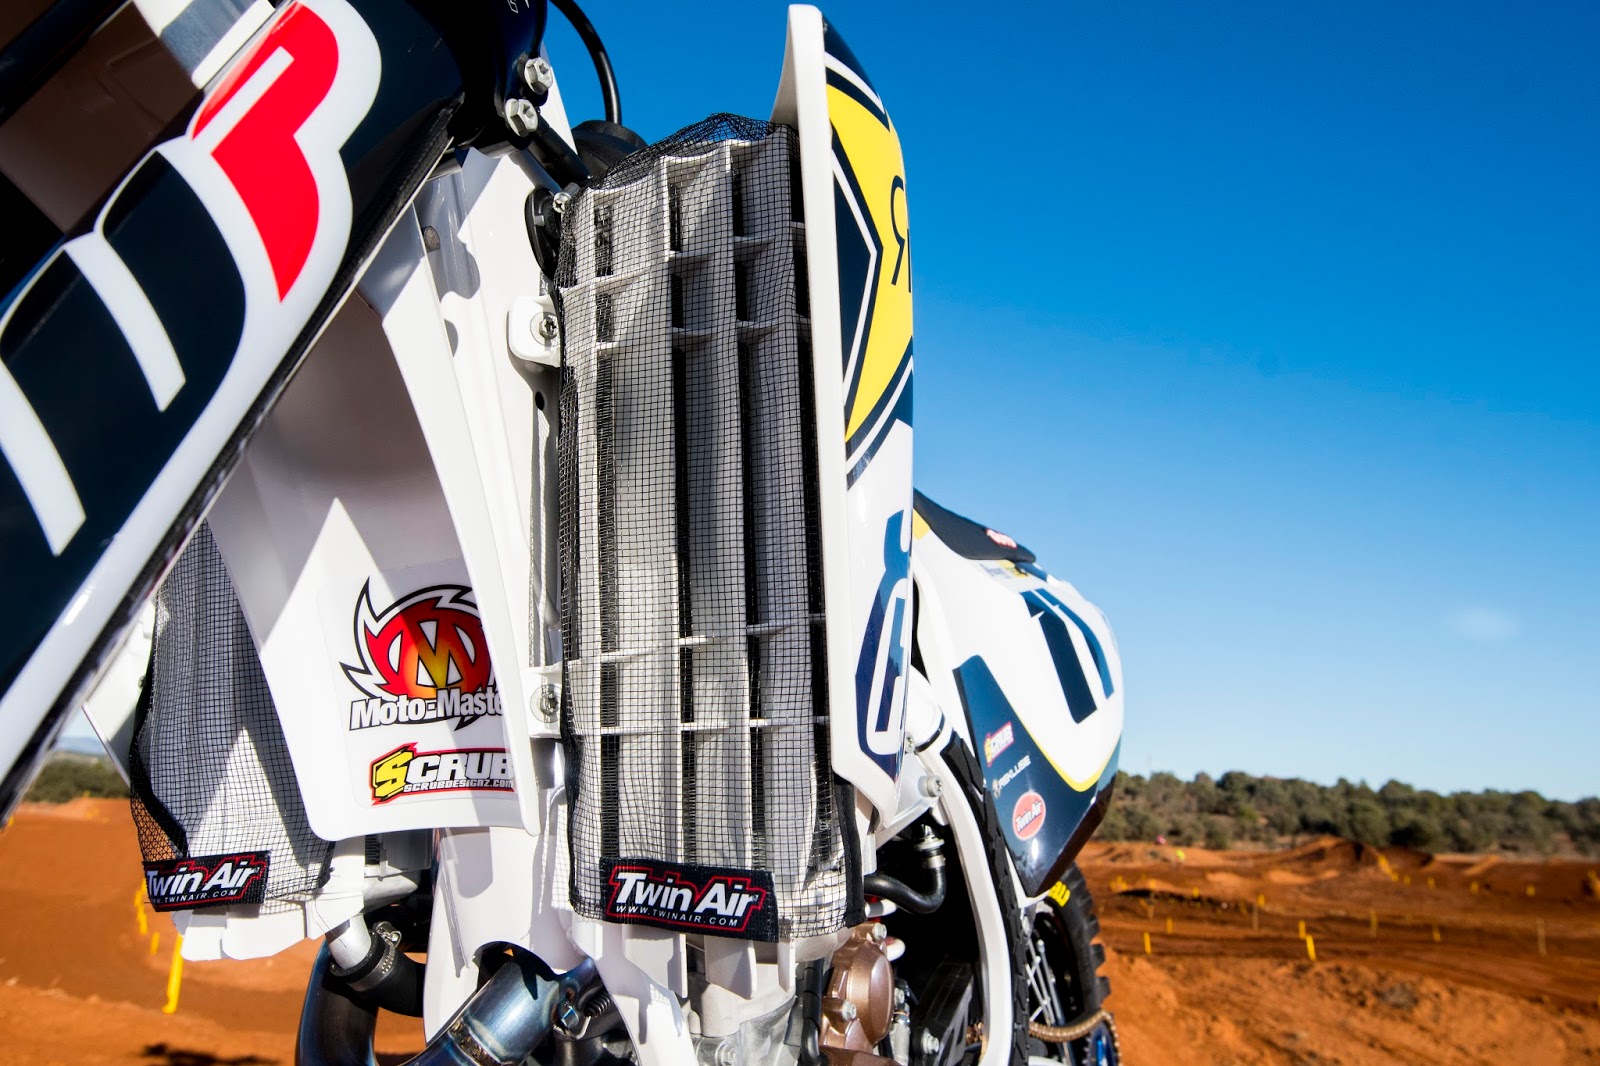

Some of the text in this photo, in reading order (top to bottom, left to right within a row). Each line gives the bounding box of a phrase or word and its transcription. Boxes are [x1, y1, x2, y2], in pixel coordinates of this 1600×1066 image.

[203, 861, 257, 892] Air
[616, 872, 755, 917] Twin Air
[615, 905, 738, 927] WWW.TWINAIR.COM
